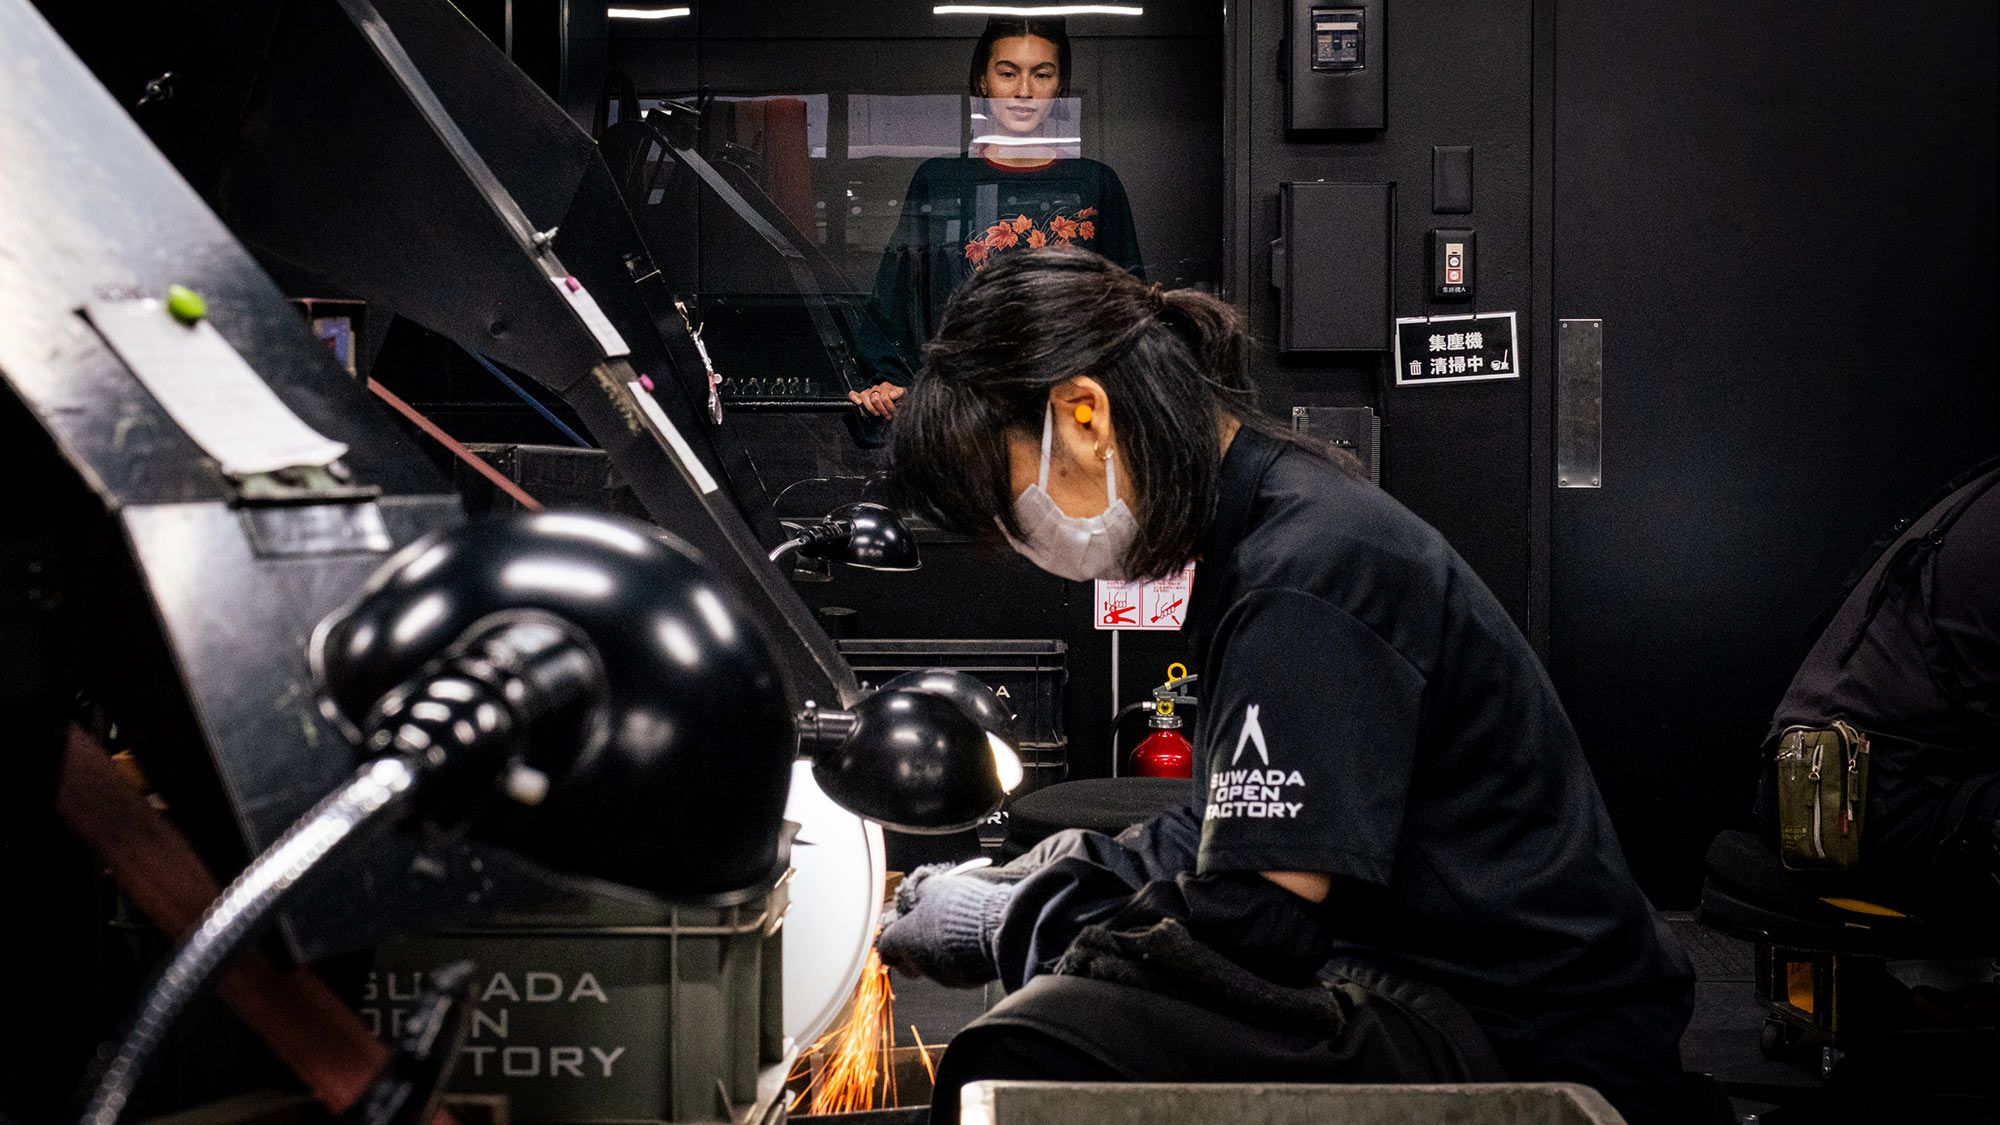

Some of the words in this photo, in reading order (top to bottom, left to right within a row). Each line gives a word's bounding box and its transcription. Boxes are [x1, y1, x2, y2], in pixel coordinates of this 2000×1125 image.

[1429, 332, 1483, 351] 集塵機
[1430, 355, 1484, 375] 清掃中
[1210, 769, 1305, 789] SUWADA
[1215, 785, 1280, 802] OPEN
[361, 971, 609, 1003] SUADA
[459, 1046, 626, 1078] TORY
